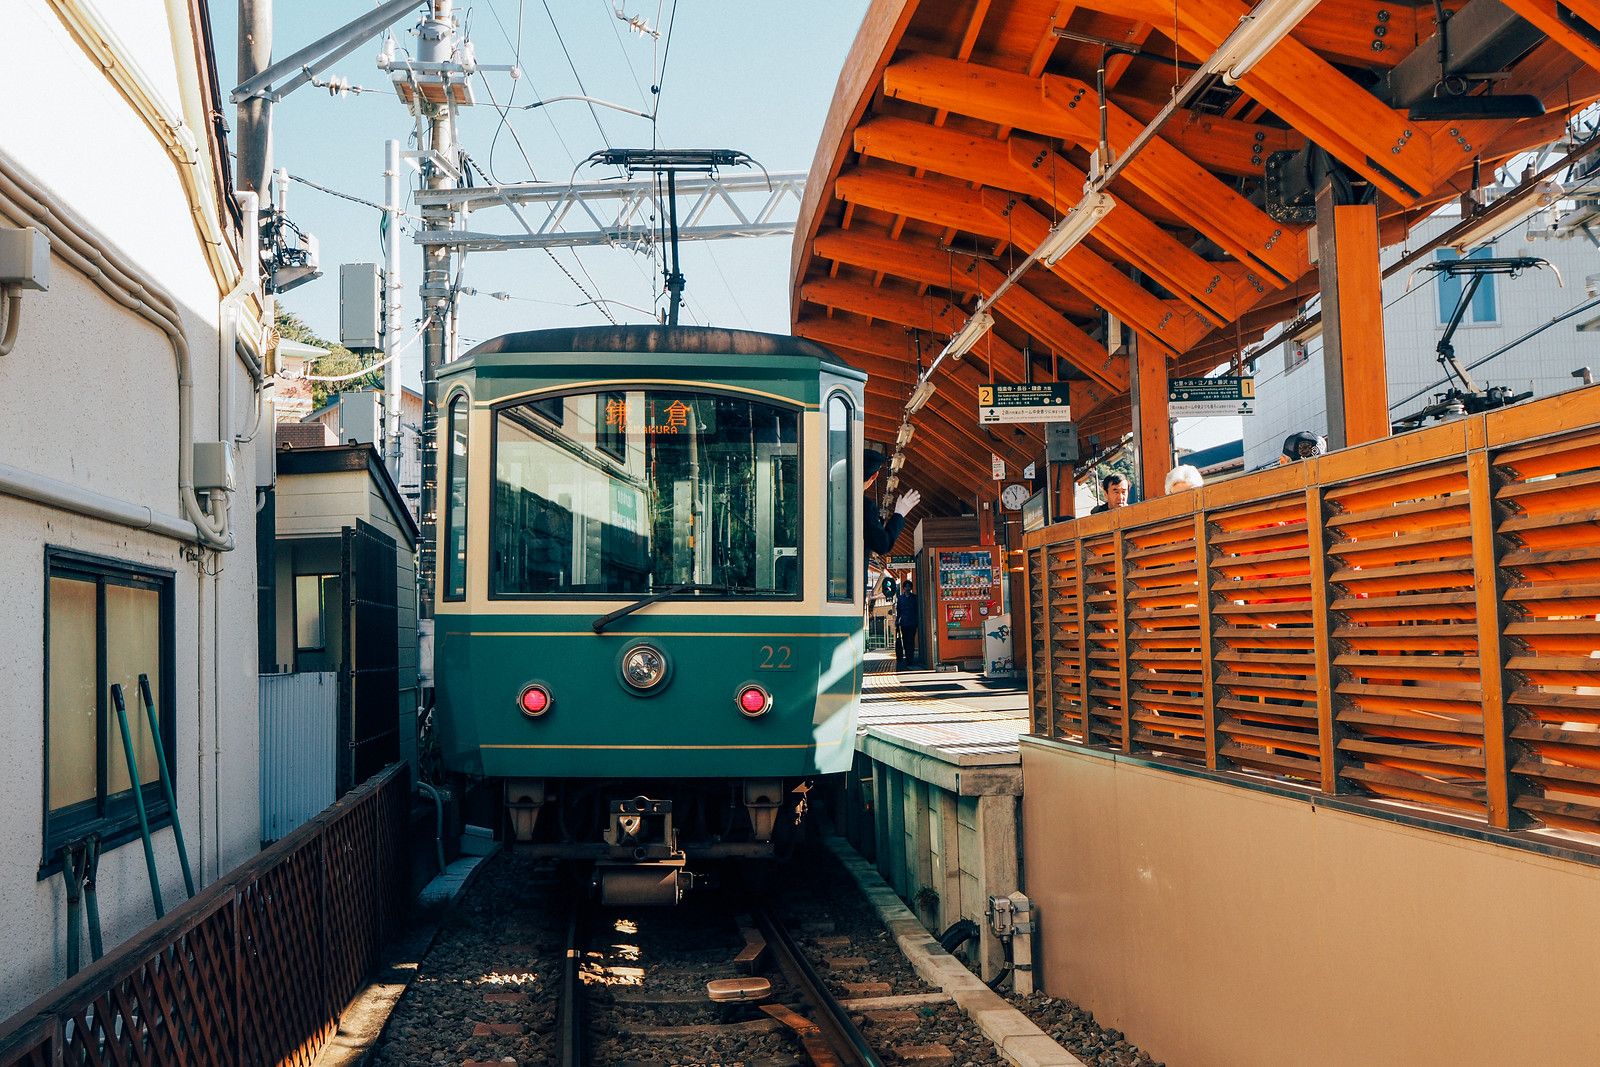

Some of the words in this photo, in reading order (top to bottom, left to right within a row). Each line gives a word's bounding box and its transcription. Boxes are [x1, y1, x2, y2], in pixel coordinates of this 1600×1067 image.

[1246, 382, 1251, 394] 1
[982, 389, 990, 402] 2
[619, 425, 678, 434] KAKURA
[759, 645, 791, 669] 22
